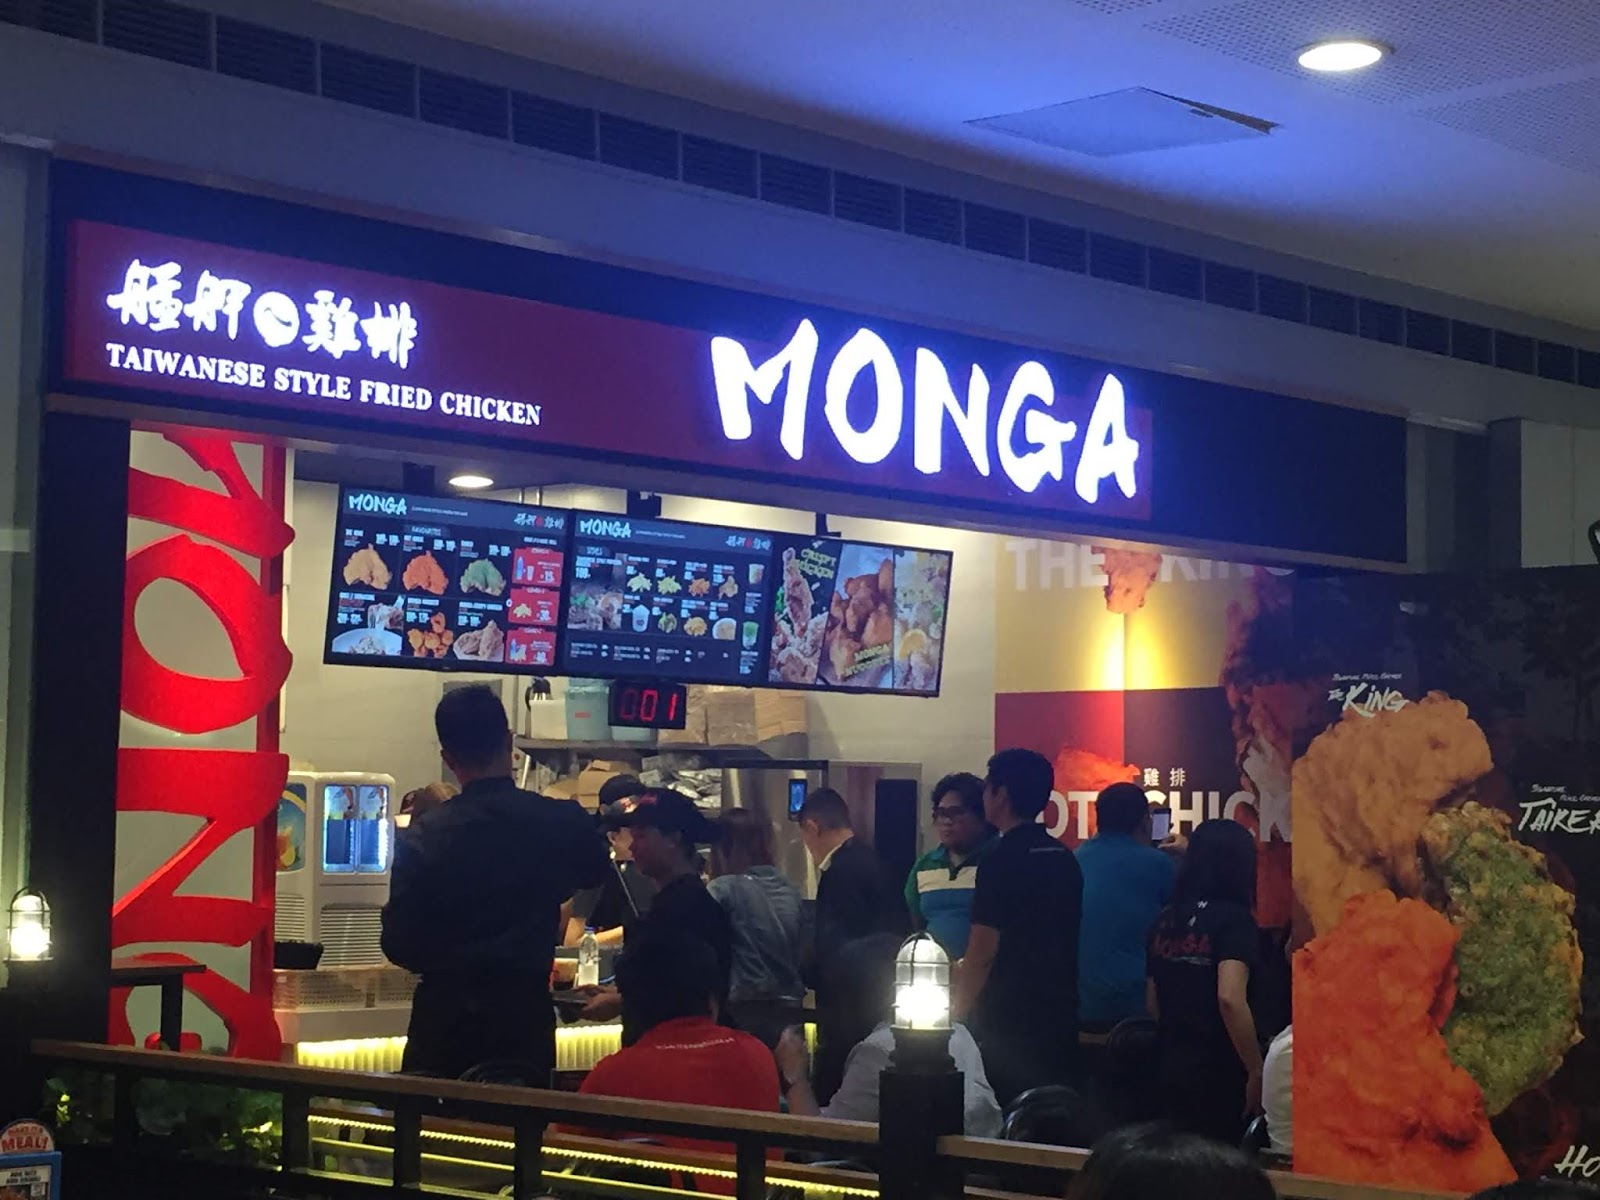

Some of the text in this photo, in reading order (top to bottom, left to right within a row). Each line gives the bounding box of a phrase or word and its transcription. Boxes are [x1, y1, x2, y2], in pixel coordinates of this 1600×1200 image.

[105, 342, 542, 426] TAIWANESE STYLE FRIED CHICKEN
[710, 318, 1139, 504] MONGA
[348, 493, 408, 516] MONGA
[579, 518, 632, 538] MONGA
[1034, 791, 1099, 841] OT
